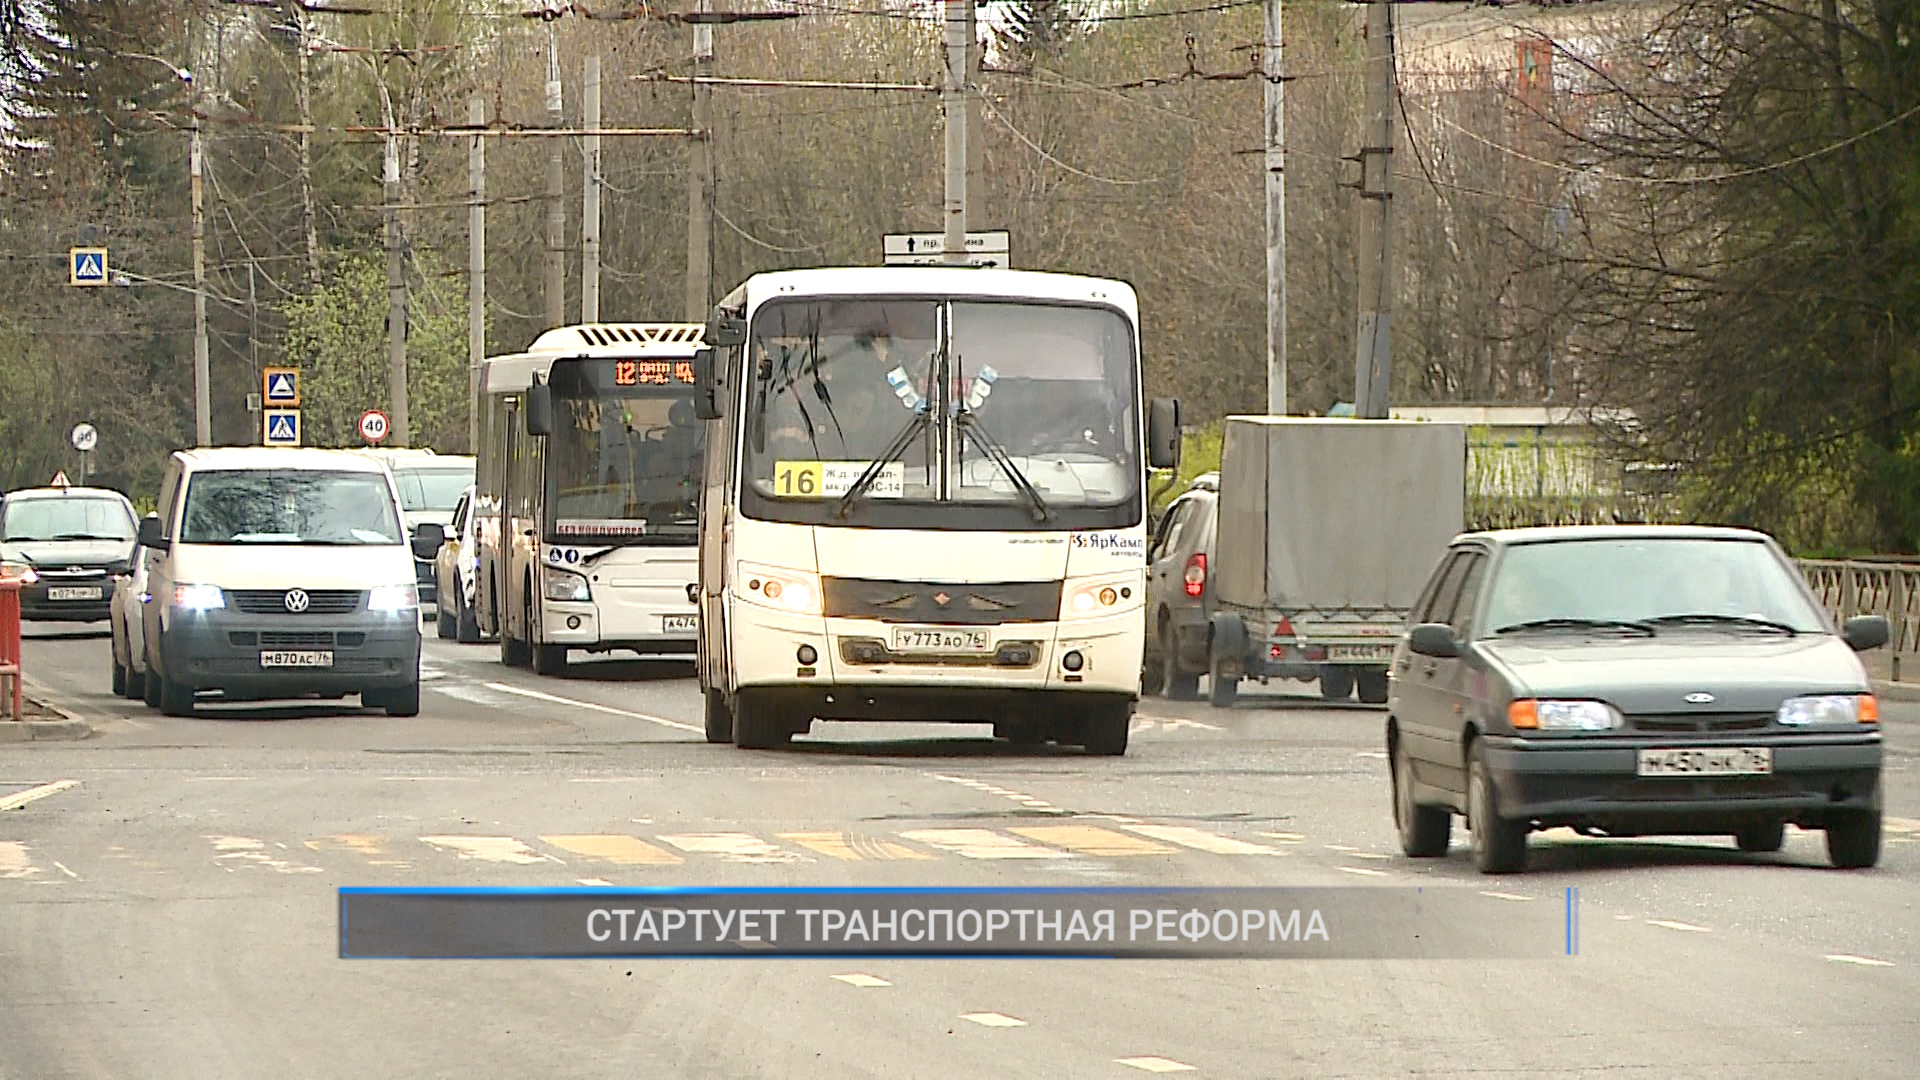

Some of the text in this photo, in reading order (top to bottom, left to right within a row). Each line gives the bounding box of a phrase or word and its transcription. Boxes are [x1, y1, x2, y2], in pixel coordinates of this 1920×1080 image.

[616, 361, 635, 384] 12
[365, 419, 383, 432] 40
[779, 469, 815, 495] 16
[1090, 534, 1143, 549] ЯрКамп
